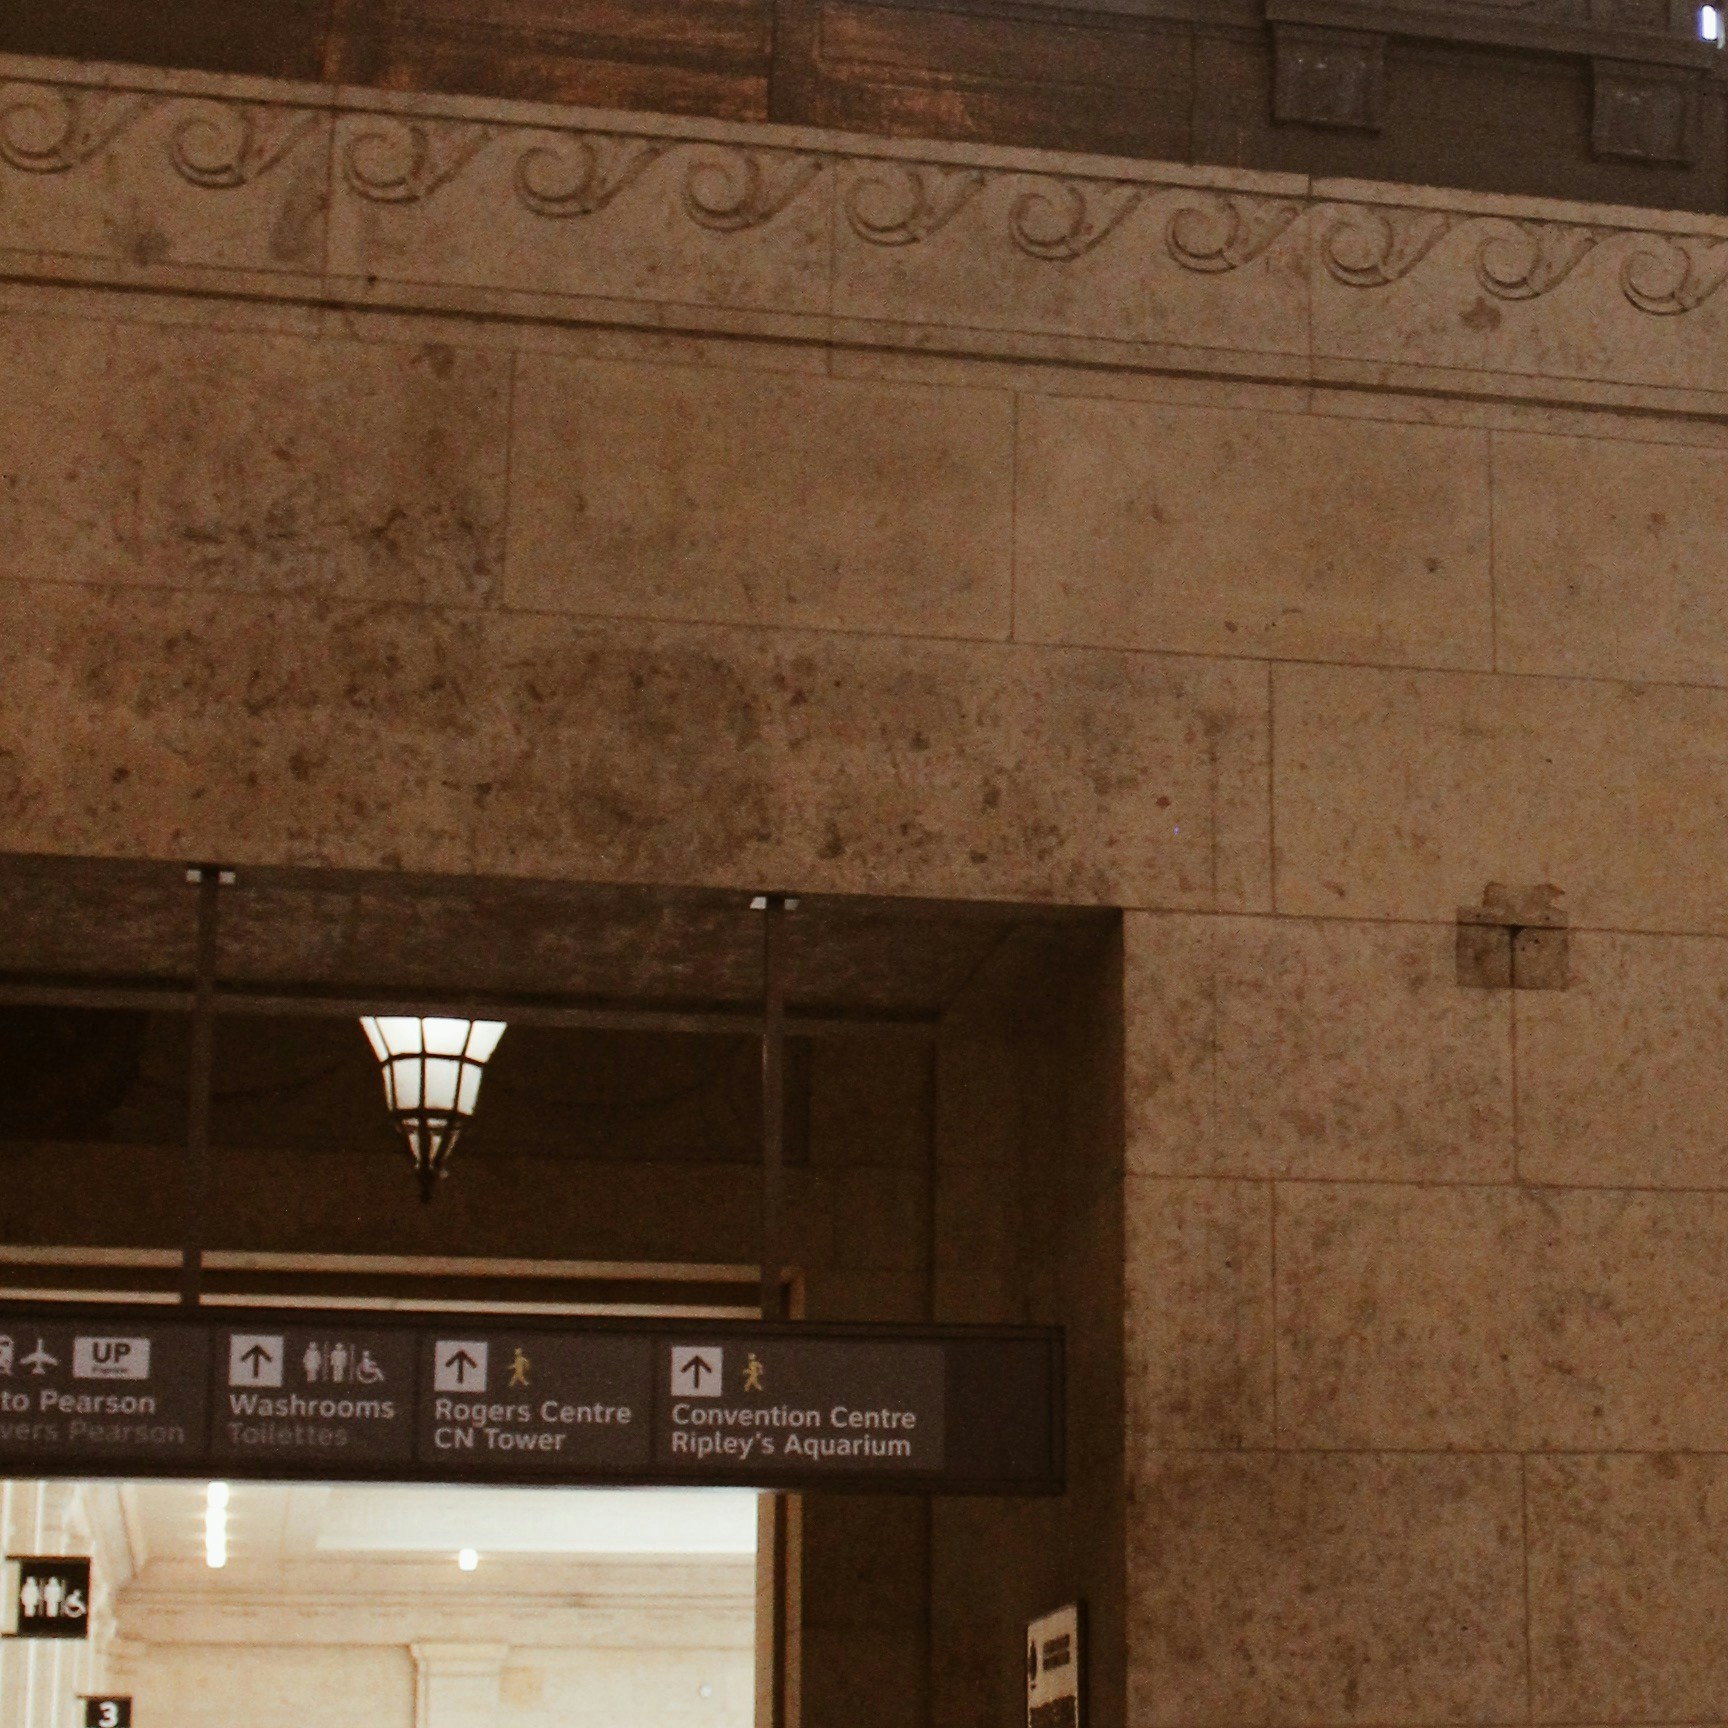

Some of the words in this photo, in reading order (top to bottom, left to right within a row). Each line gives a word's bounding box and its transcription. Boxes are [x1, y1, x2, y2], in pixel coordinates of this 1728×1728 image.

[93, 1341, 131, 1364] UP
[1, 1390, 31, 1412] to
[40, 1388, 156, 1415] Pearson
[229, 1393, 395, 1419] Washrooms
[435, 1398, 532, 1428] Rogers
[540, 1400, 632, 1424] Centre
[671, 1403, 822, 1428] Convention
[830, 1406, 917, 1430] Centre
[69, 1420, 186, 1445] Pearson
[228, 1422, 350, 1447] Toilettes
[434, 1426, 475, 1450] CN
[484, 1427, 567, 1451] Tower
[671, 1430, 775, 1461] Ripley's
[784, 1433, 912, 1462] Aquarium
[98, 1700, 119, 1728] 3
